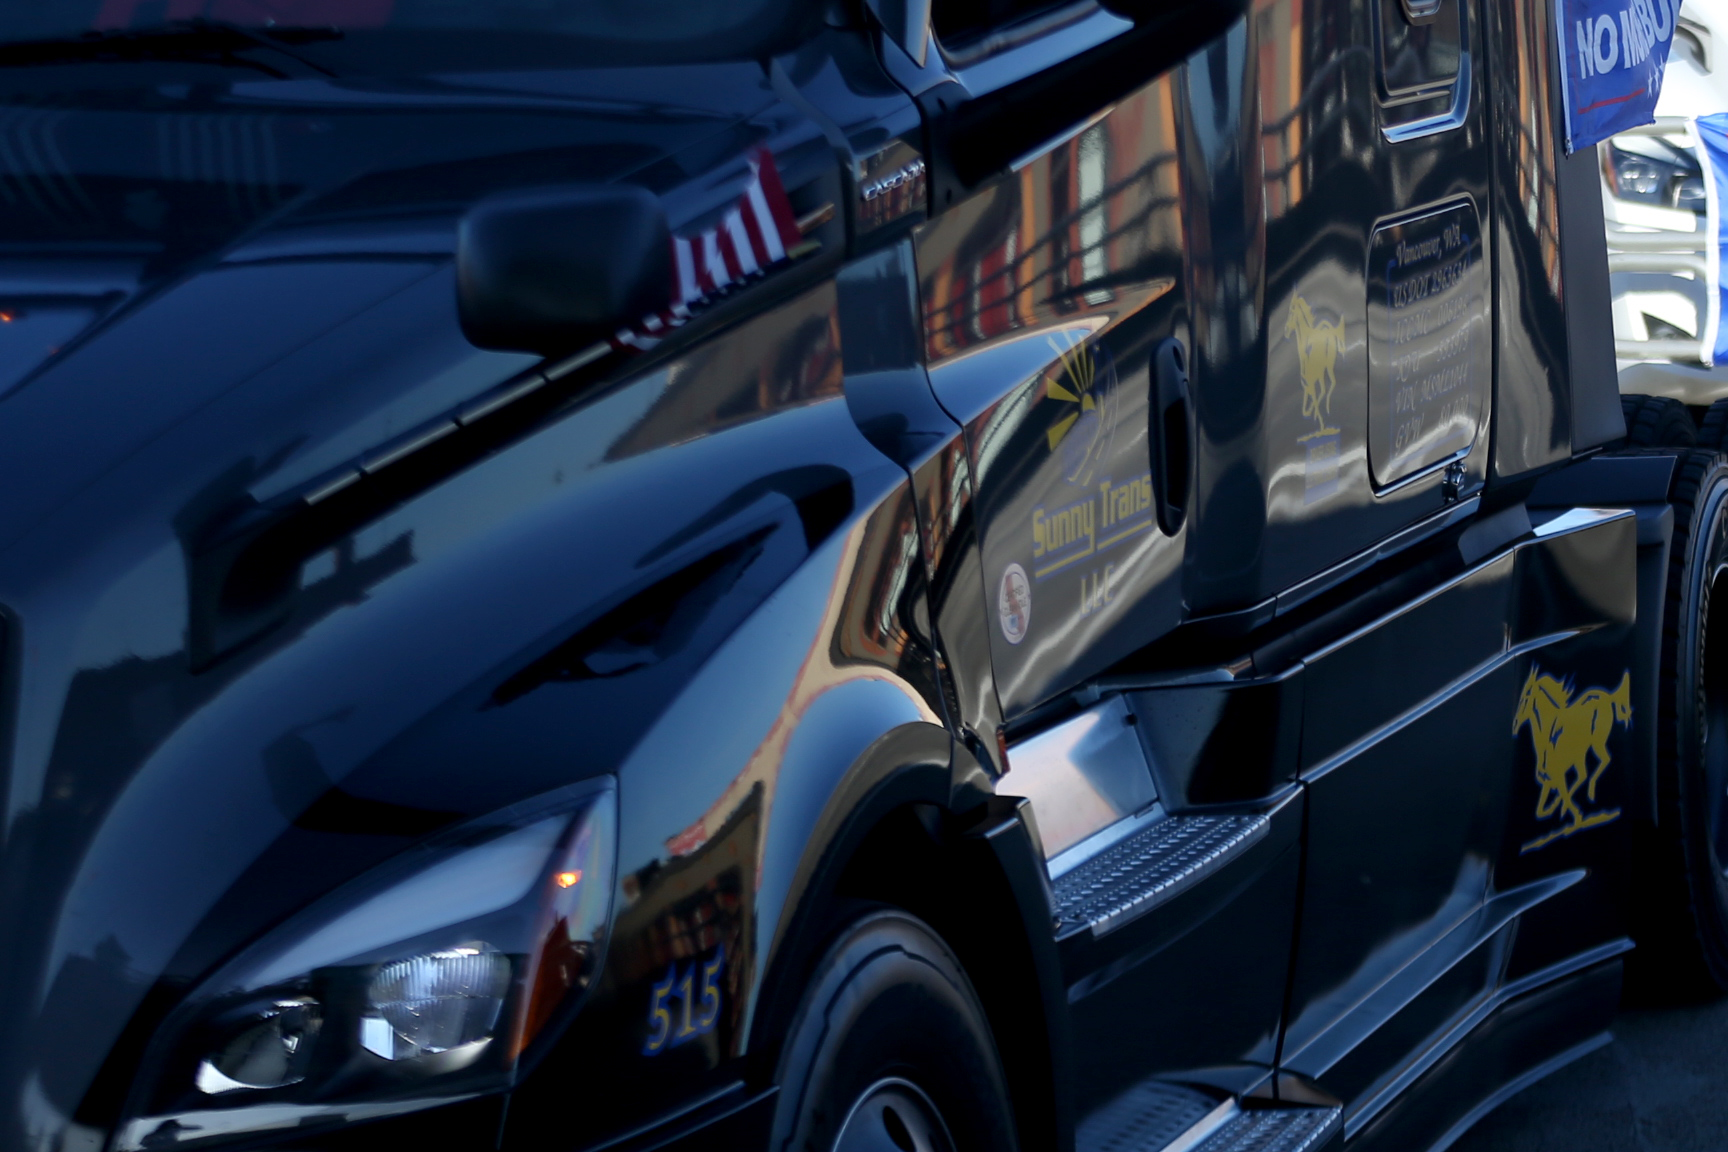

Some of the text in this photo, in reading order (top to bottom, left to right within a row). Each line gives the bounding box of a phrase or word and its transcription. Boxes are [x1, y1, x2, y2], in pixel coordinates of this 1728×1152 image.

[1576, 14, 1618, 81] NO
[1032, 472, 1151, 560] Sunny Trans
[1080, 564, 1114, 615] LLC
[645, 947, 724, 1053] 515
